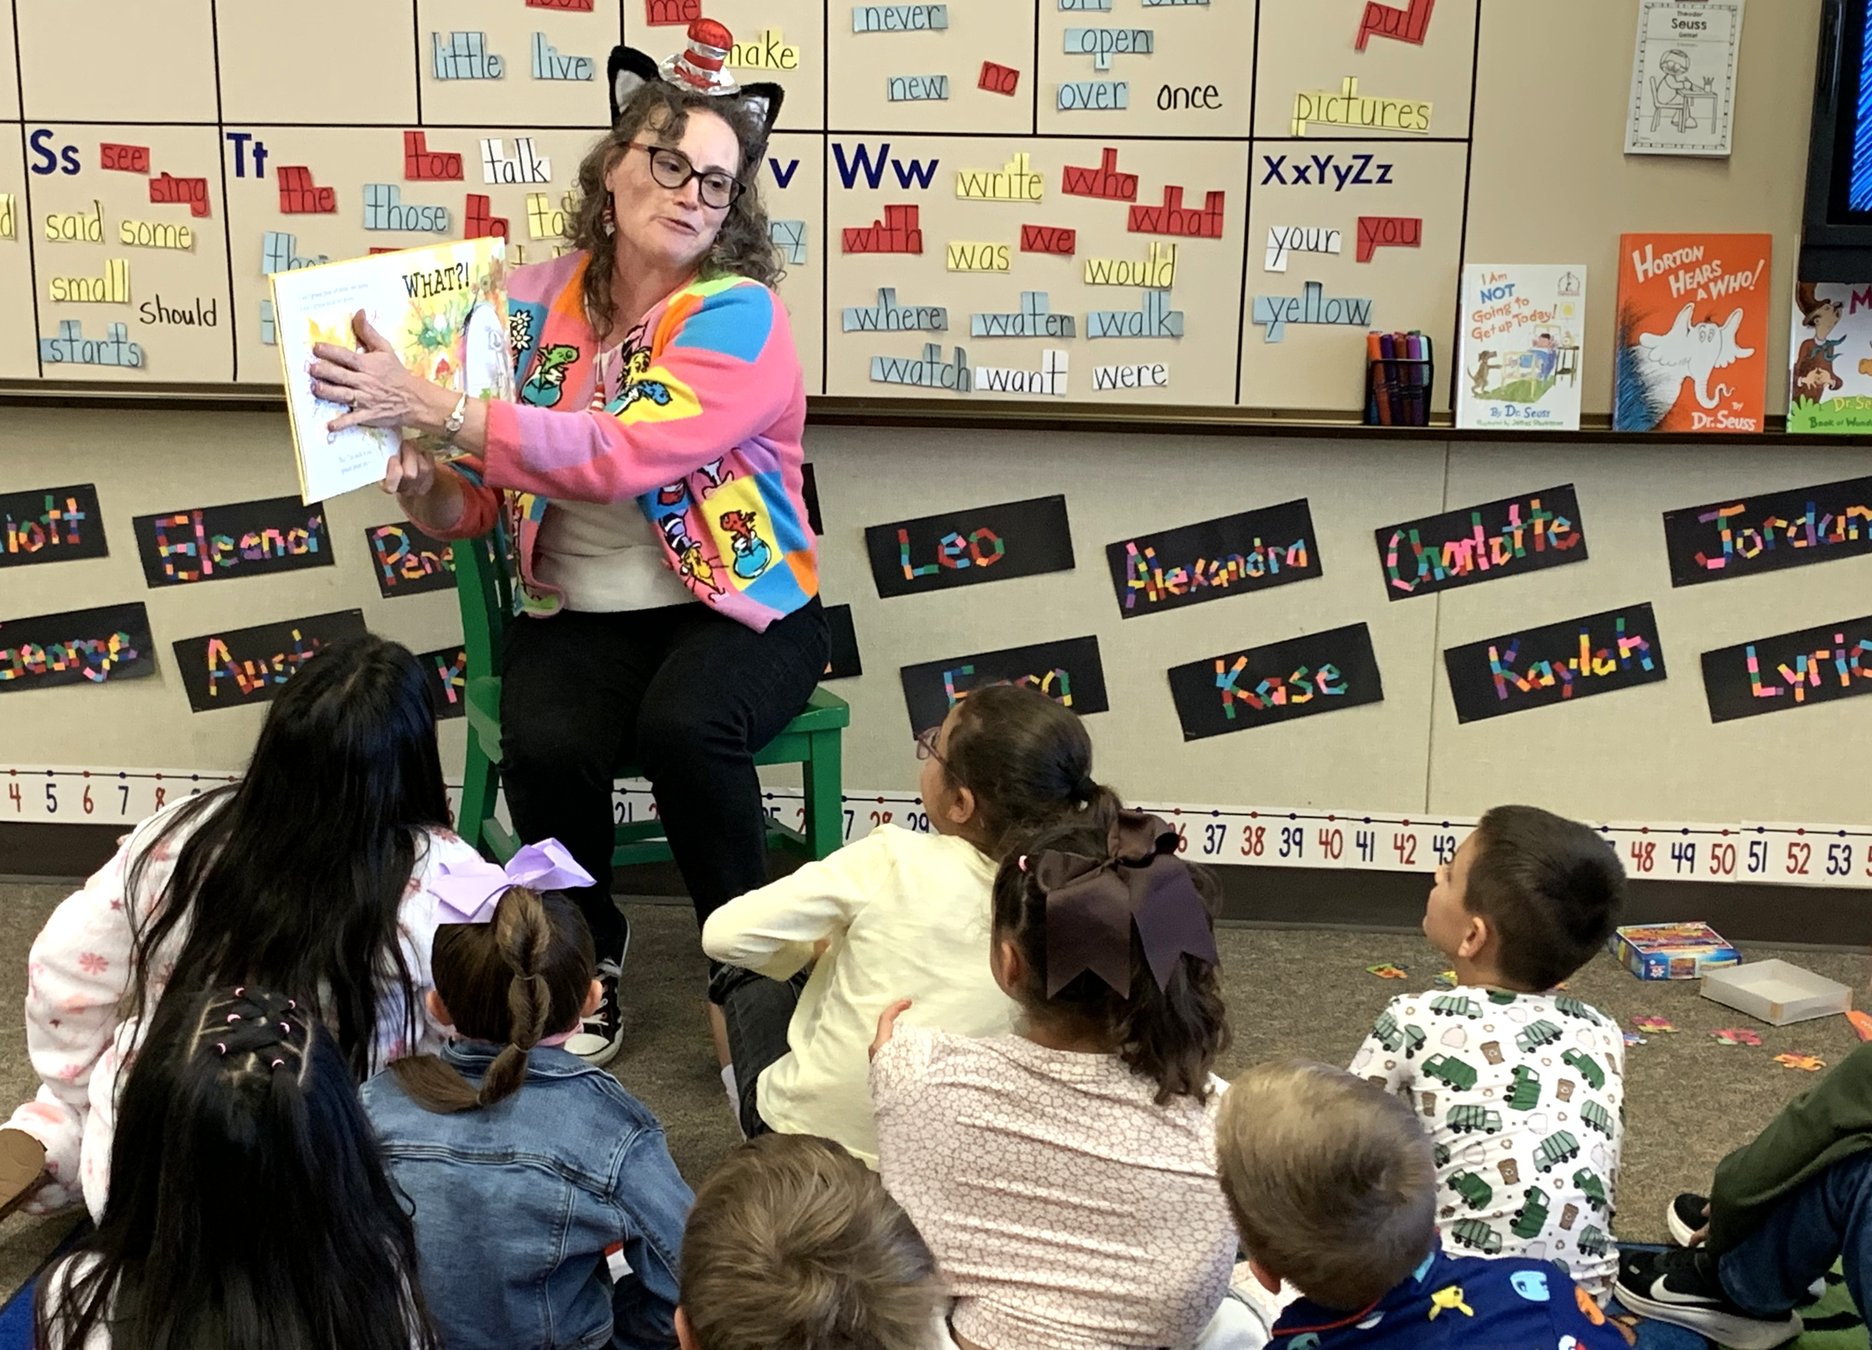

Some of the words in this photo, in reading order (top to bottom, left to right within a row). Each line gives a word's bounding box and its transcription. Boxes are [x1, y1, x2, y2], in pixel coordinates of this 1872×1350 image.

[865, 4, 947, 32] never
[1359, 0, 1432, 50] pull
[1671, 18, 1708, 31] Seuss
[432, 32, 502, 79] little
[535, 32, 593, 81] live
[1080, 28, 1151, 66] open
[890, 76, 947, 101] new
[982, 64, 1019, 95] no
[1059, 82, 1127, 110] over
[1157, 84, 1223, 111] once
[1294, 76, 1430, 136] pictures
[30, 129, 81, 175] Ss
[102, 145, 146, 172] see
[226, 132, 268, 178] Tt
[406, 131, 461, 180] too
[484, 138, 550, 184] talk
[832, 142, 939, 190] Ww
[1065, 148, 1137, 200] who
[151, 174, 208, 216] sing
[280, 168, 335, 214] the
[960, 152, 1043, 202] write
[46, 199, 103, 242] said
[120, 220, 191, 250] some
[366, 185, 447, 232] those
[467, 195, 507, 239] to
[1132, 187, 1223, 237] what
[844, 205, 923, 253] with
[950, 242, 1010, 271] was
[1024, 226, 1072, 254] we
[1087, 242, 1176, 289] would
[1269, 226, 1341, 267] your
[1359, 217, 1419, 261] you
[52, 260, 127, 302] small
[402, 262, 470, 299] WHAT?!
[1480, 283, 1516, 304] NOT
[1481, 273, 1487, 286] I
[1489, 271, 1508, 285] Am
[1668, 259, 1722, 299] HEARS
[1697, 287, 1709, 301] A
[1709, 259, 1765, 300] WHO!
[855, 290, 942, 331] where
[982, 292, 1072, 337] water
[1100, 291, 1176, 338] walk
[1267, 283, 1372, 338] yellow
[1471, 302, 1513, 324] Going
[1514, 296, 1531, 310] to
[1471, 323, 1497, 342] Get
[1499, 319, 1513, 334] up
[1512, 303, 1558, 328] Today!
[49, 321, 142, 368] starts
[880, 344, 971, 390] watch
[986, 350, 1067, 395] want
[1094, 362, 1167, 389] were
[1523, 406, 1551, 419] Seuss
[1691, 411, 1716, 430] Dr.
[1716, 410, 1757, 432] Seuss
[898, 527, 1005, 580] Leo
[1387, 499, 1581, 592] Charlotte
[1124, 537, 1308, 608] Alexandra
[1215, 655, 1349, 720] Kase
[9, 782, 22, 813] 4
[45, 783, 58, 814] 5
[82, 784, 95, 815] 6
[117, 785, 130, 816] 7
[1203, 824, 1227, 855] 37
[1240, 825, 1267, 857] 38
[1279, 826, 1304, 859] 39
[1318, 828, 1344, 860] 40
[1356, 830, 1376, 863] 41
[1393, 833, 1417, 865] 42
[1432, 834, 1456, 866] 43
[1631, 840, 1657, 873] 48
[1671, 842, 1696, 874] 49
[1709, 843, 1736, 876] 50
[1747, 840, 1768, 874] 51
[1786, 842, 1812, 875] 52
[1826, 843, 1853, 876] 53
